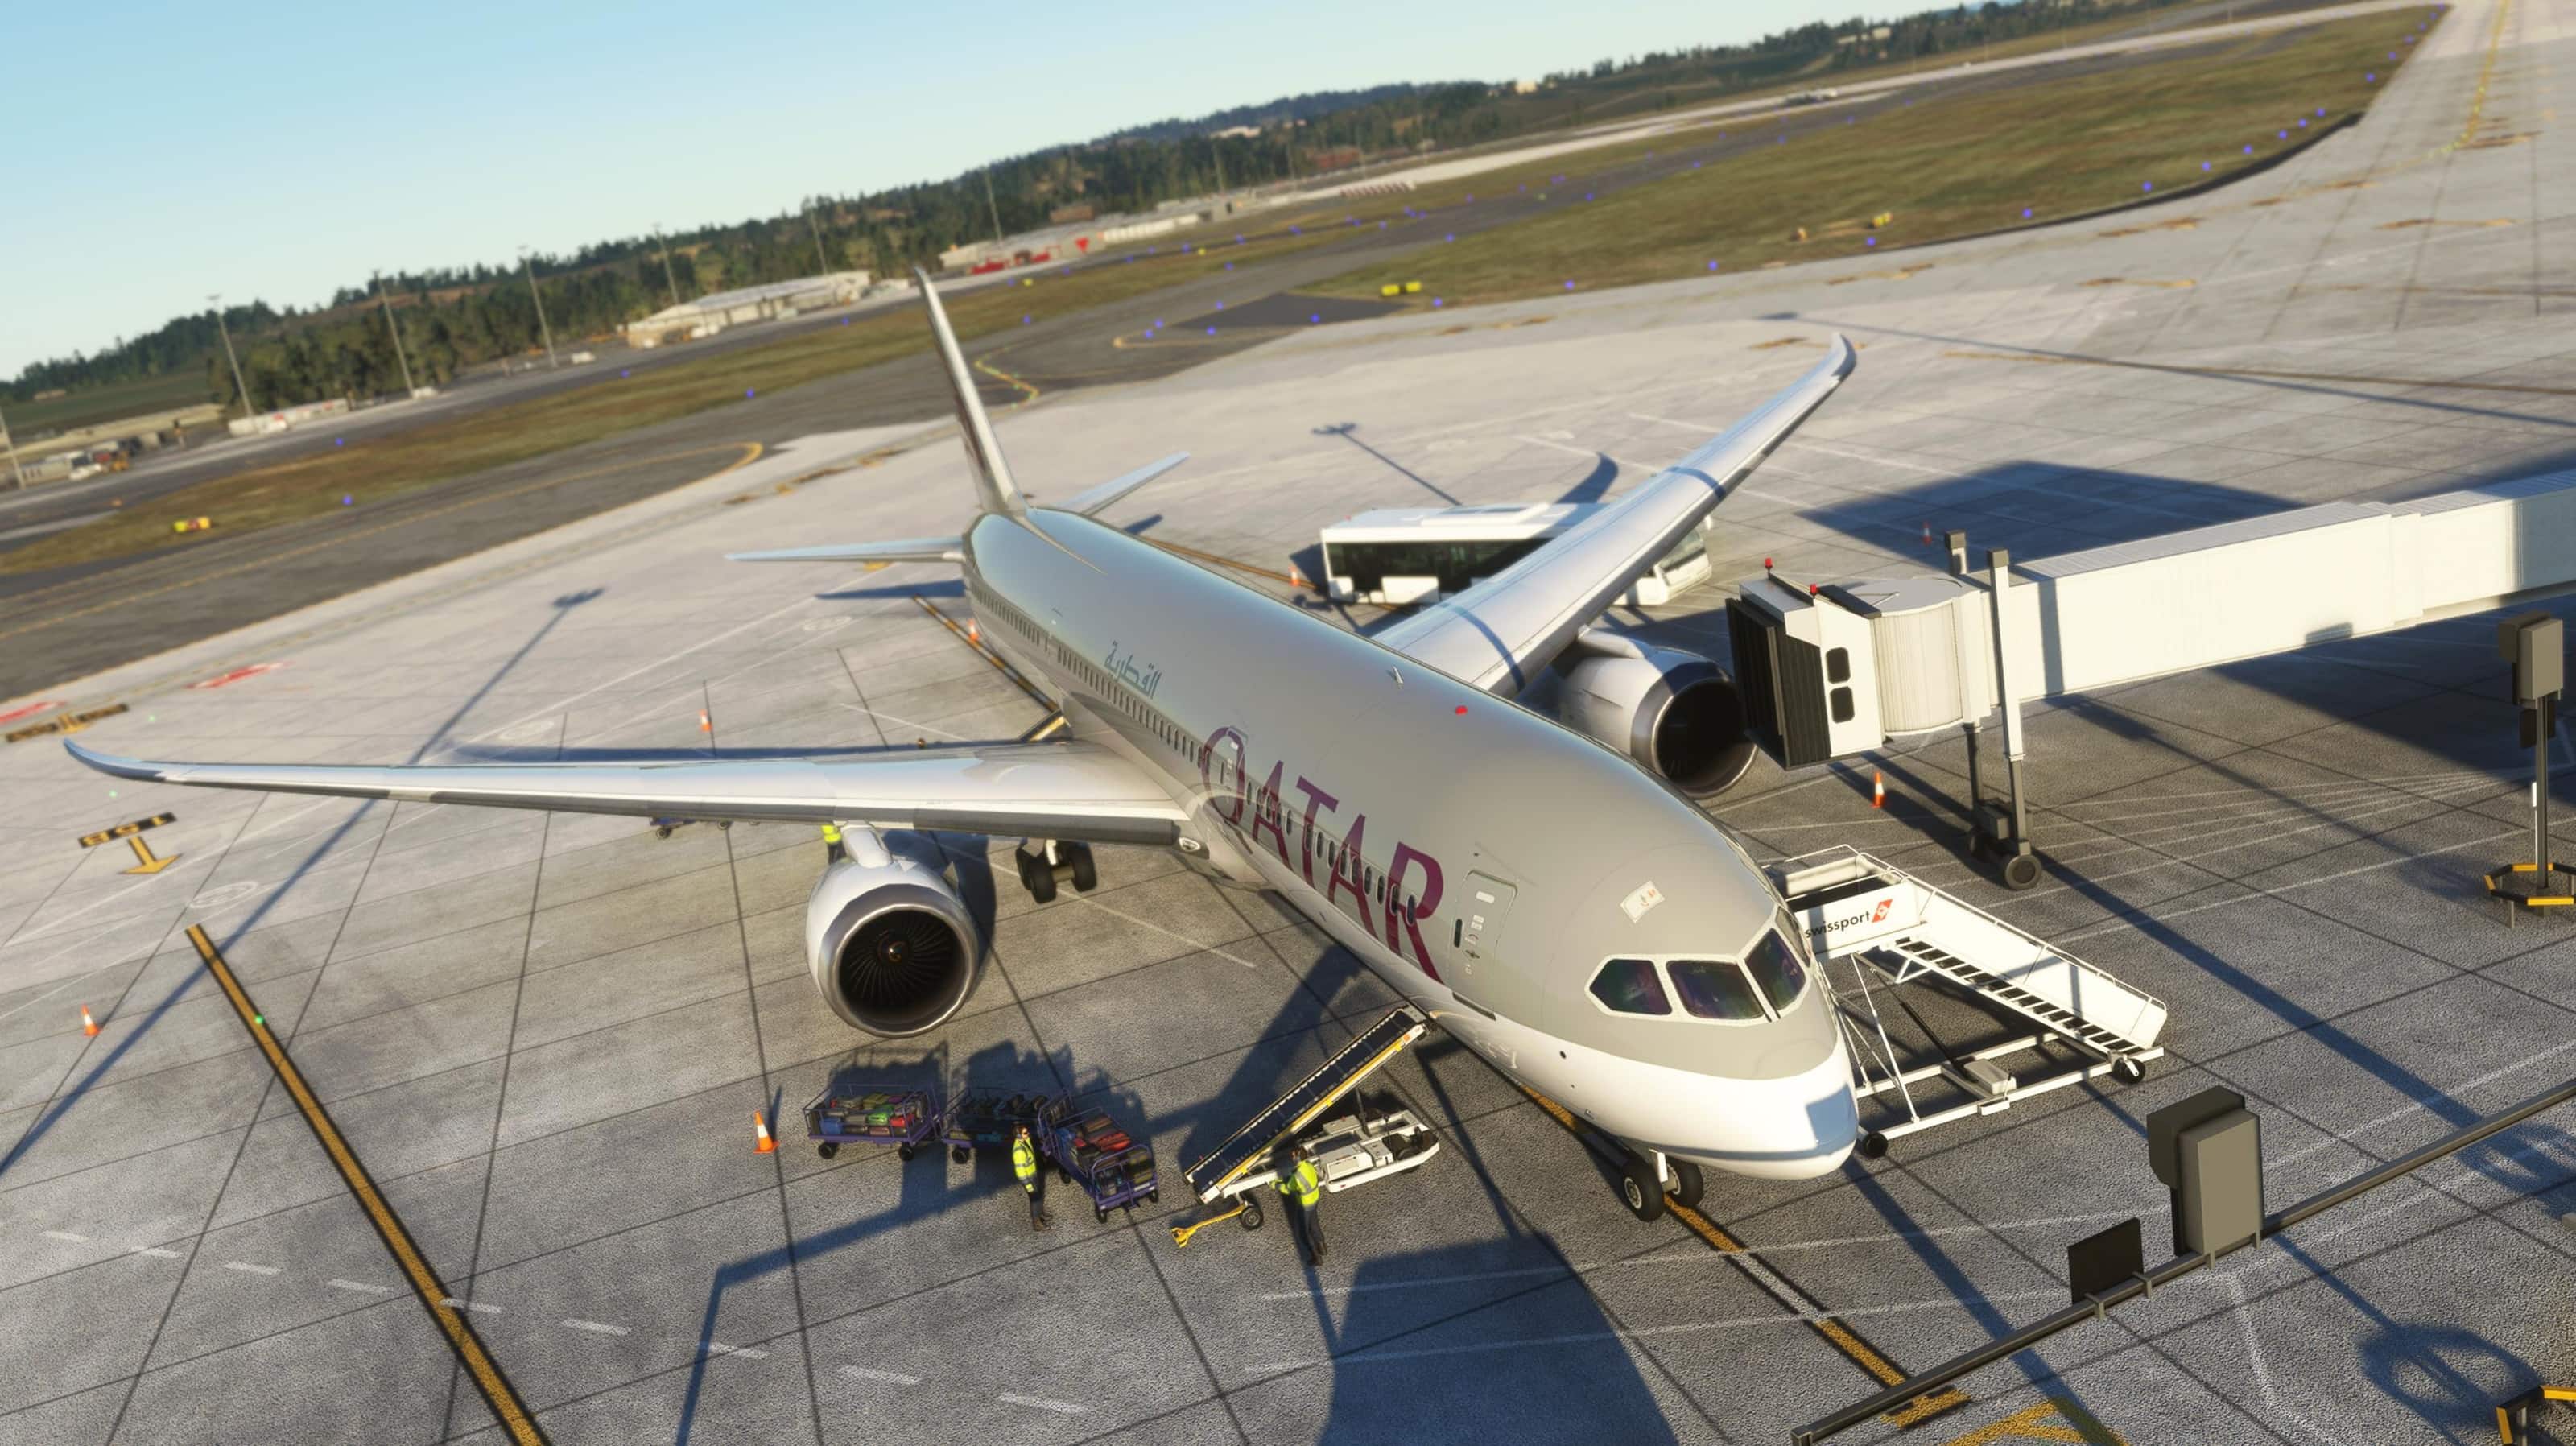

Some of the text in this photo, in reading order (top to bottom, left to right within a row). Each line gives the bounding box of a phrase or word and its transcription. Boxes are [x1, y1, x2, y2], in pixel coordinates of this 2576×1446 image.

[1104, 640, 1162, 700] القطرية
[1201, 726, 1444, 985] QATAR
[1805, 911, 1869, 938] swissport
